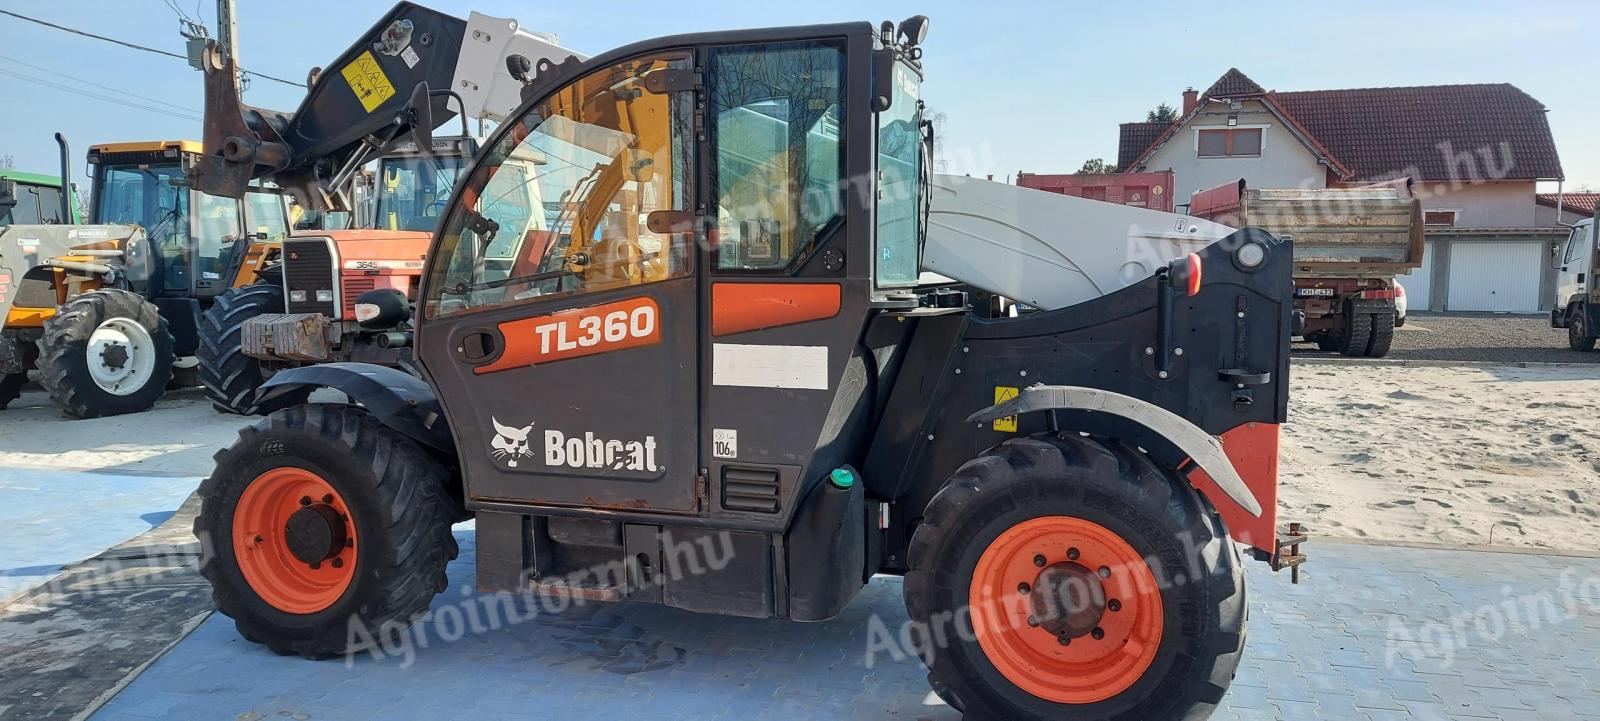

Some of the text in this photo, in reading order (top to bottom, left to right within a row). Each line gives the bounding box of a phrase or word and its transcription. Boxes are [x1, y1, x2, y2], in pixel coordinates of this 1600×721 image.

[356, 261, 378, 269] 3645
[535, 306, 655, 354] TL360
[544, 430, 657, 472] Bobcat
[715, 441, 730, 456] 106
